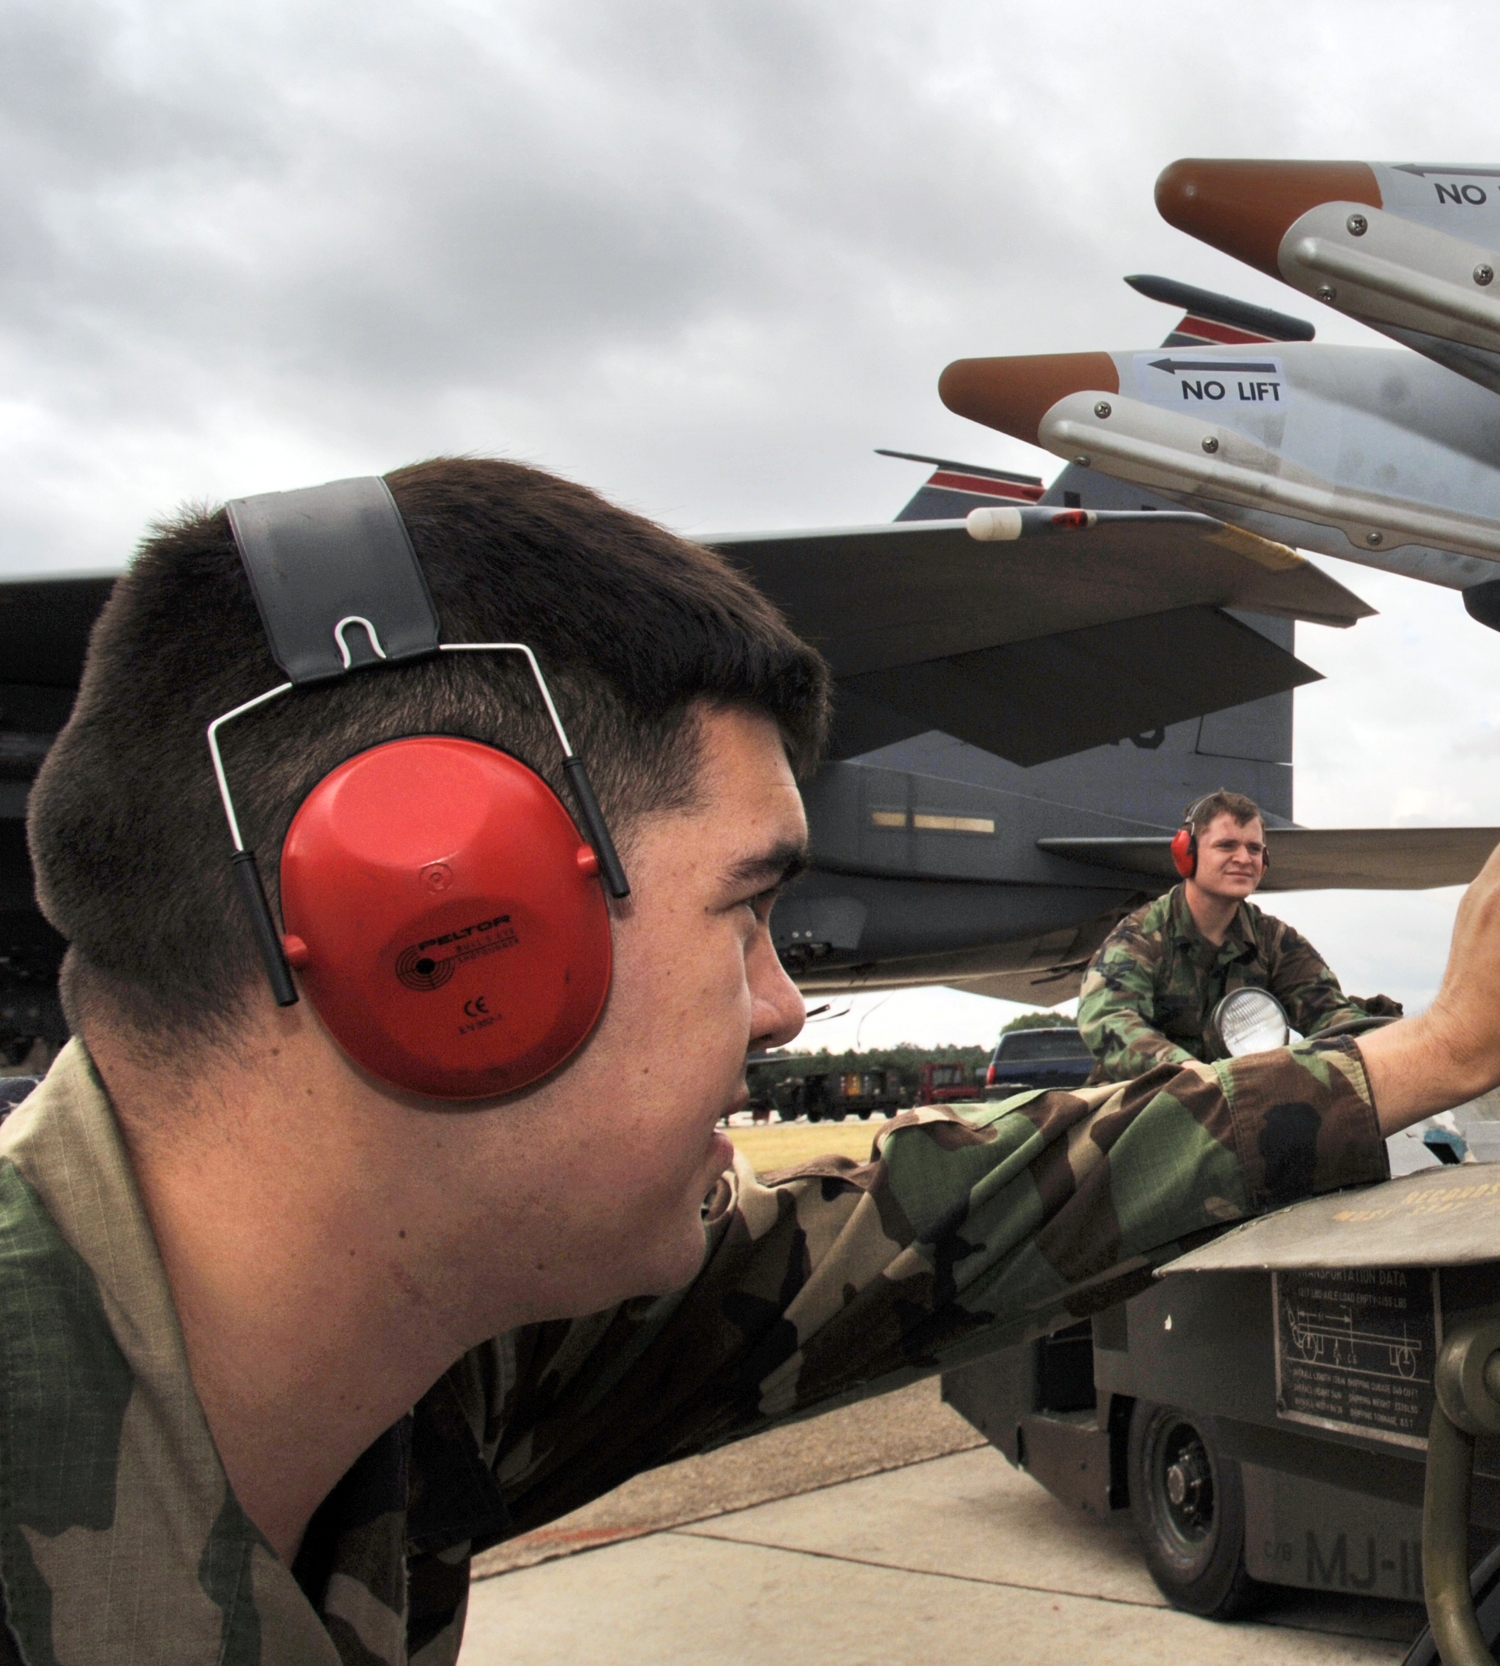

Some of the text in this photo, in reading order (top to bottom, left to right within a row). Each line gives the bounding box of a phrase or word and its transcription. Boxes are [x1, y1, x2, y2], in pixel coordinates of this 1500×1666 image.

[1434, 183, 1487, 207] NO
[1182, 381, 1281, 402] NO LIFT
[418, 914, 511, 951] PELTOR
[1379, 1272, 1407, 1287] DATA
